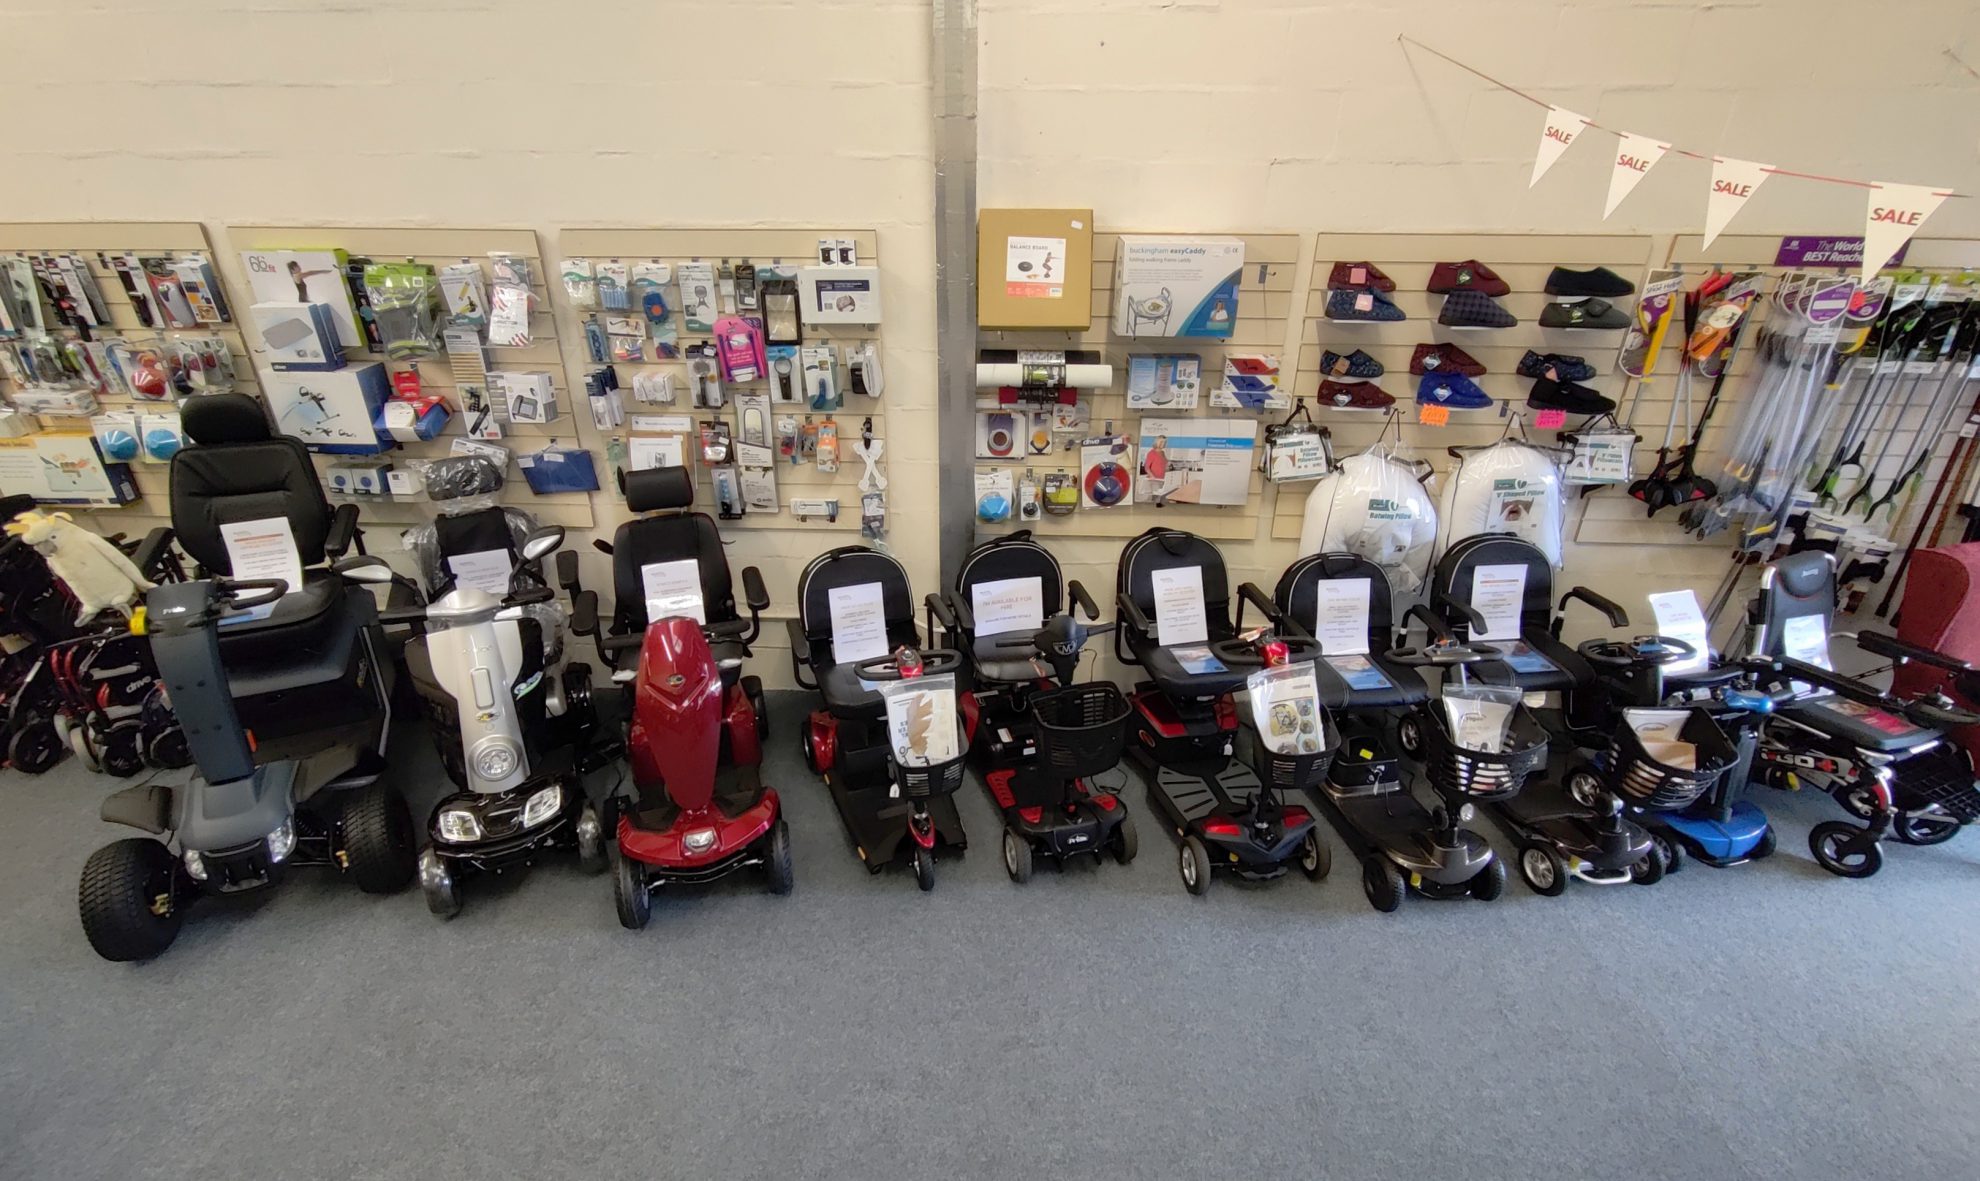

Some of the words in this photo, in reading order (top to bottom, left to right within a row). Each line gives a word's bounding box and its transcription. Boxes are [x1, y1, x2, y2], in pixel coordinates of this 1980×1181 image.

[1544, 126, 1573, 145] SALE
[1617, 154, 1650, 173] SALE
[1712, 179, 1752, 198] SALE
[1870, 207, 1924, 226] SALE
[1129, 247, 1169, 255] buckingham
[1170, 247, 1207, 256] easyCaddy
[1816, 240, 1834, 250] The
[1833, 240, 1865, 251] World
[1802, 251, 1831, 262] BEST
[1830, 251, 1864, 262] Reache
[1369, 512, 1394, 520] Batwing
[1395, 512, 1412, 520] Pillow
[126, 675, 152, 694] drive
